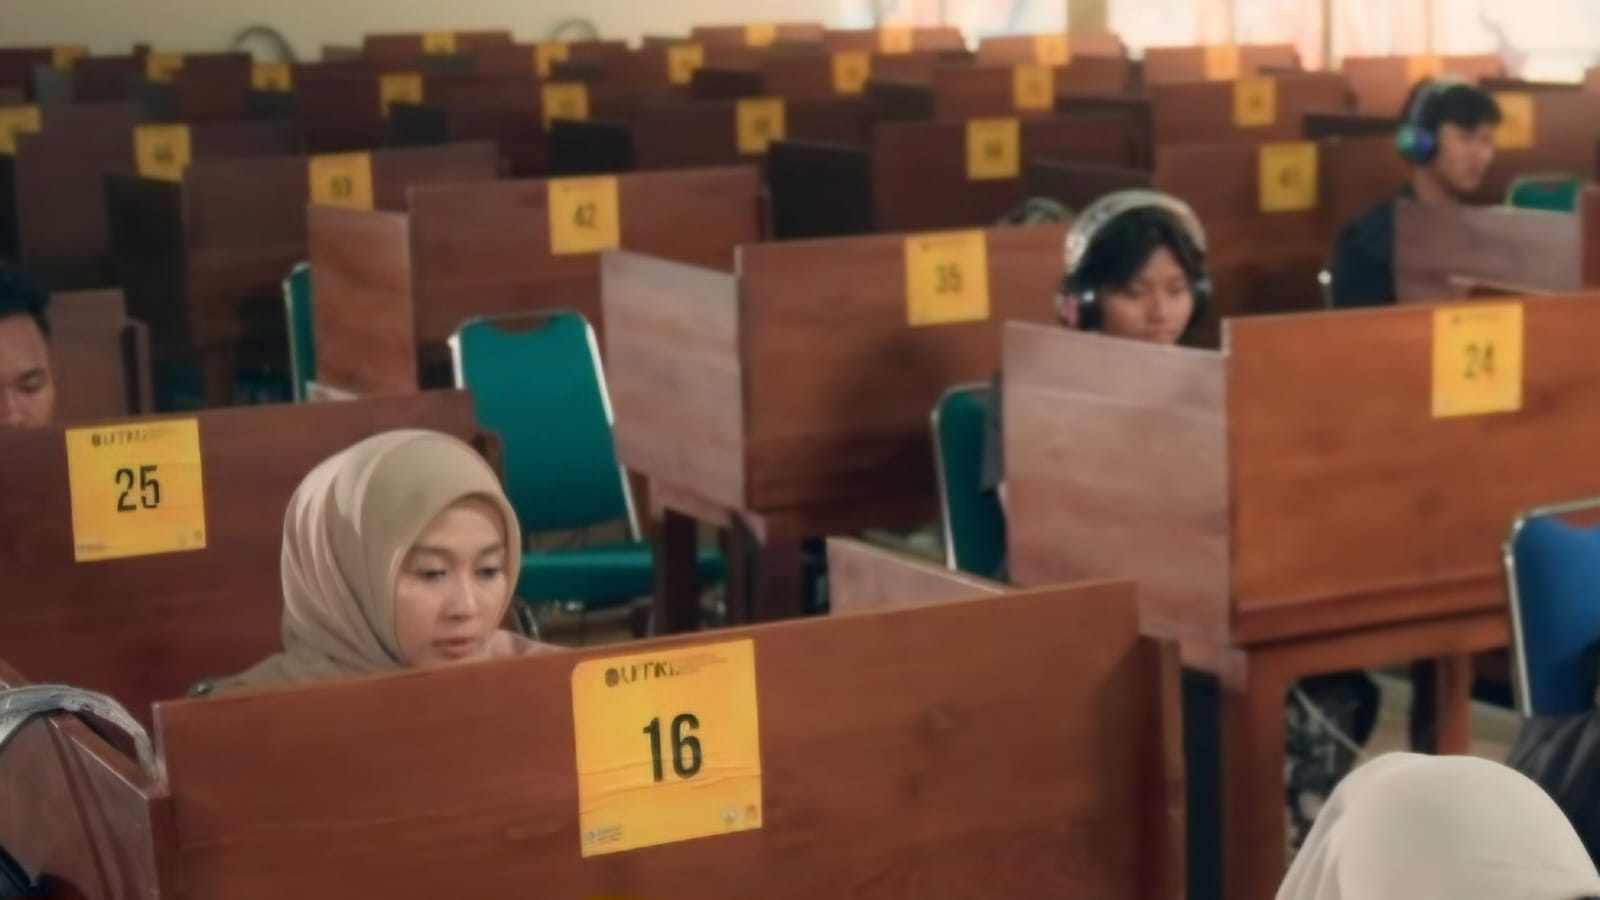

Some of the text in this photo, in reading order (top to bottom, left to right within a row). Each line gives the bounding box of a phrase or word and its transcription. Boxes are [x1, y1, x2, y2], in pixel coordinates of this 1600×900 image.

[933, 262, 964, 296] 35
[1463, 342, 1496, 380] 24
[115, 464, 160, 513] 25
[642, 713, 703, 783] 16
